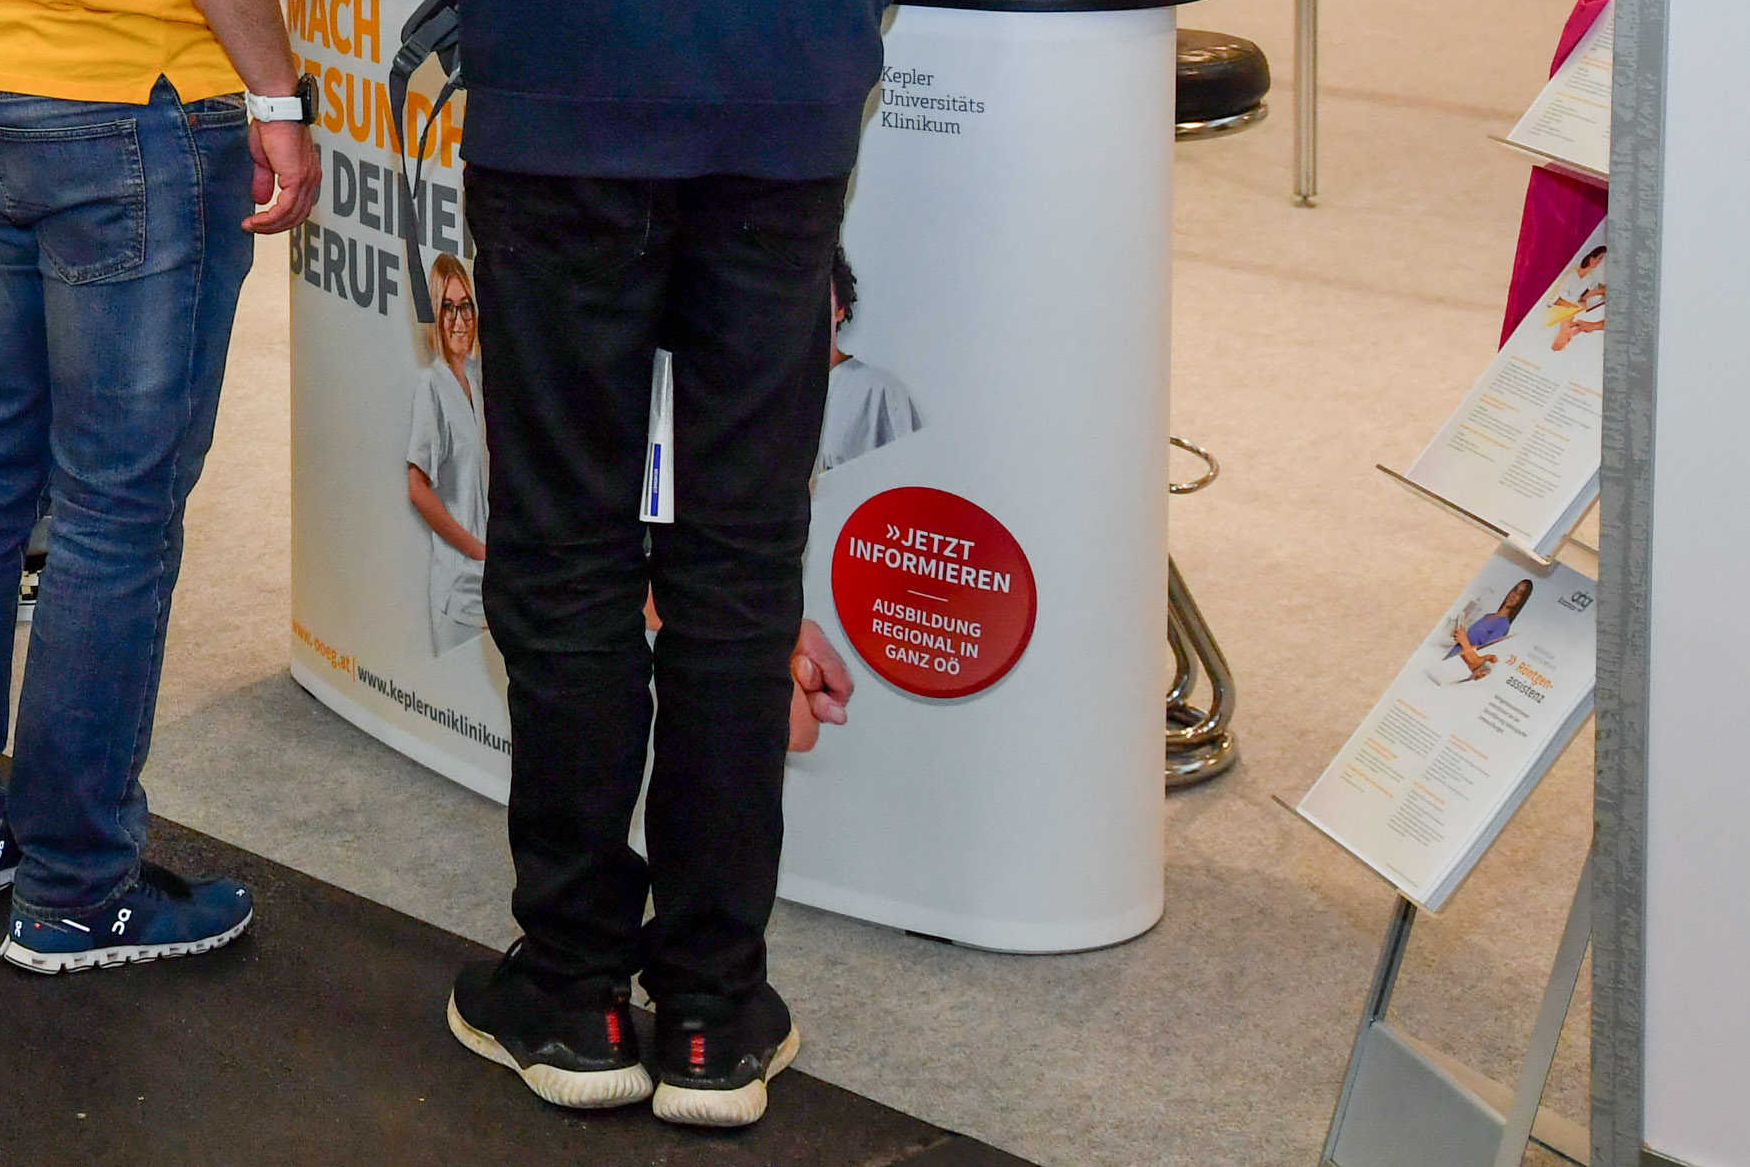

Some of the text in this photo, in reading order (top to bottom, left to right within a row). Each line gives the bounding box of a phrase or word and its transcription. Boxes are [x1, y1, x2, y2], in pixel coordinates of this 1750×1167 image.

[881, 65, 934, 89] Kepler
[881, 89, 985, 114] Universitäts
[881, 111, 961, 135] Klinikum
[290, 220, 400, 316] BERUF
[849, 536, 1011, 594] INFORMIEREN
[872, 598, 982, 638] AUSBILDUNG
[872, 618, 979, 659] REGIONAL IN
[885, 644, 961, 676] GANZ OÖ
[1506, 675, 1545, 704] assistenz
